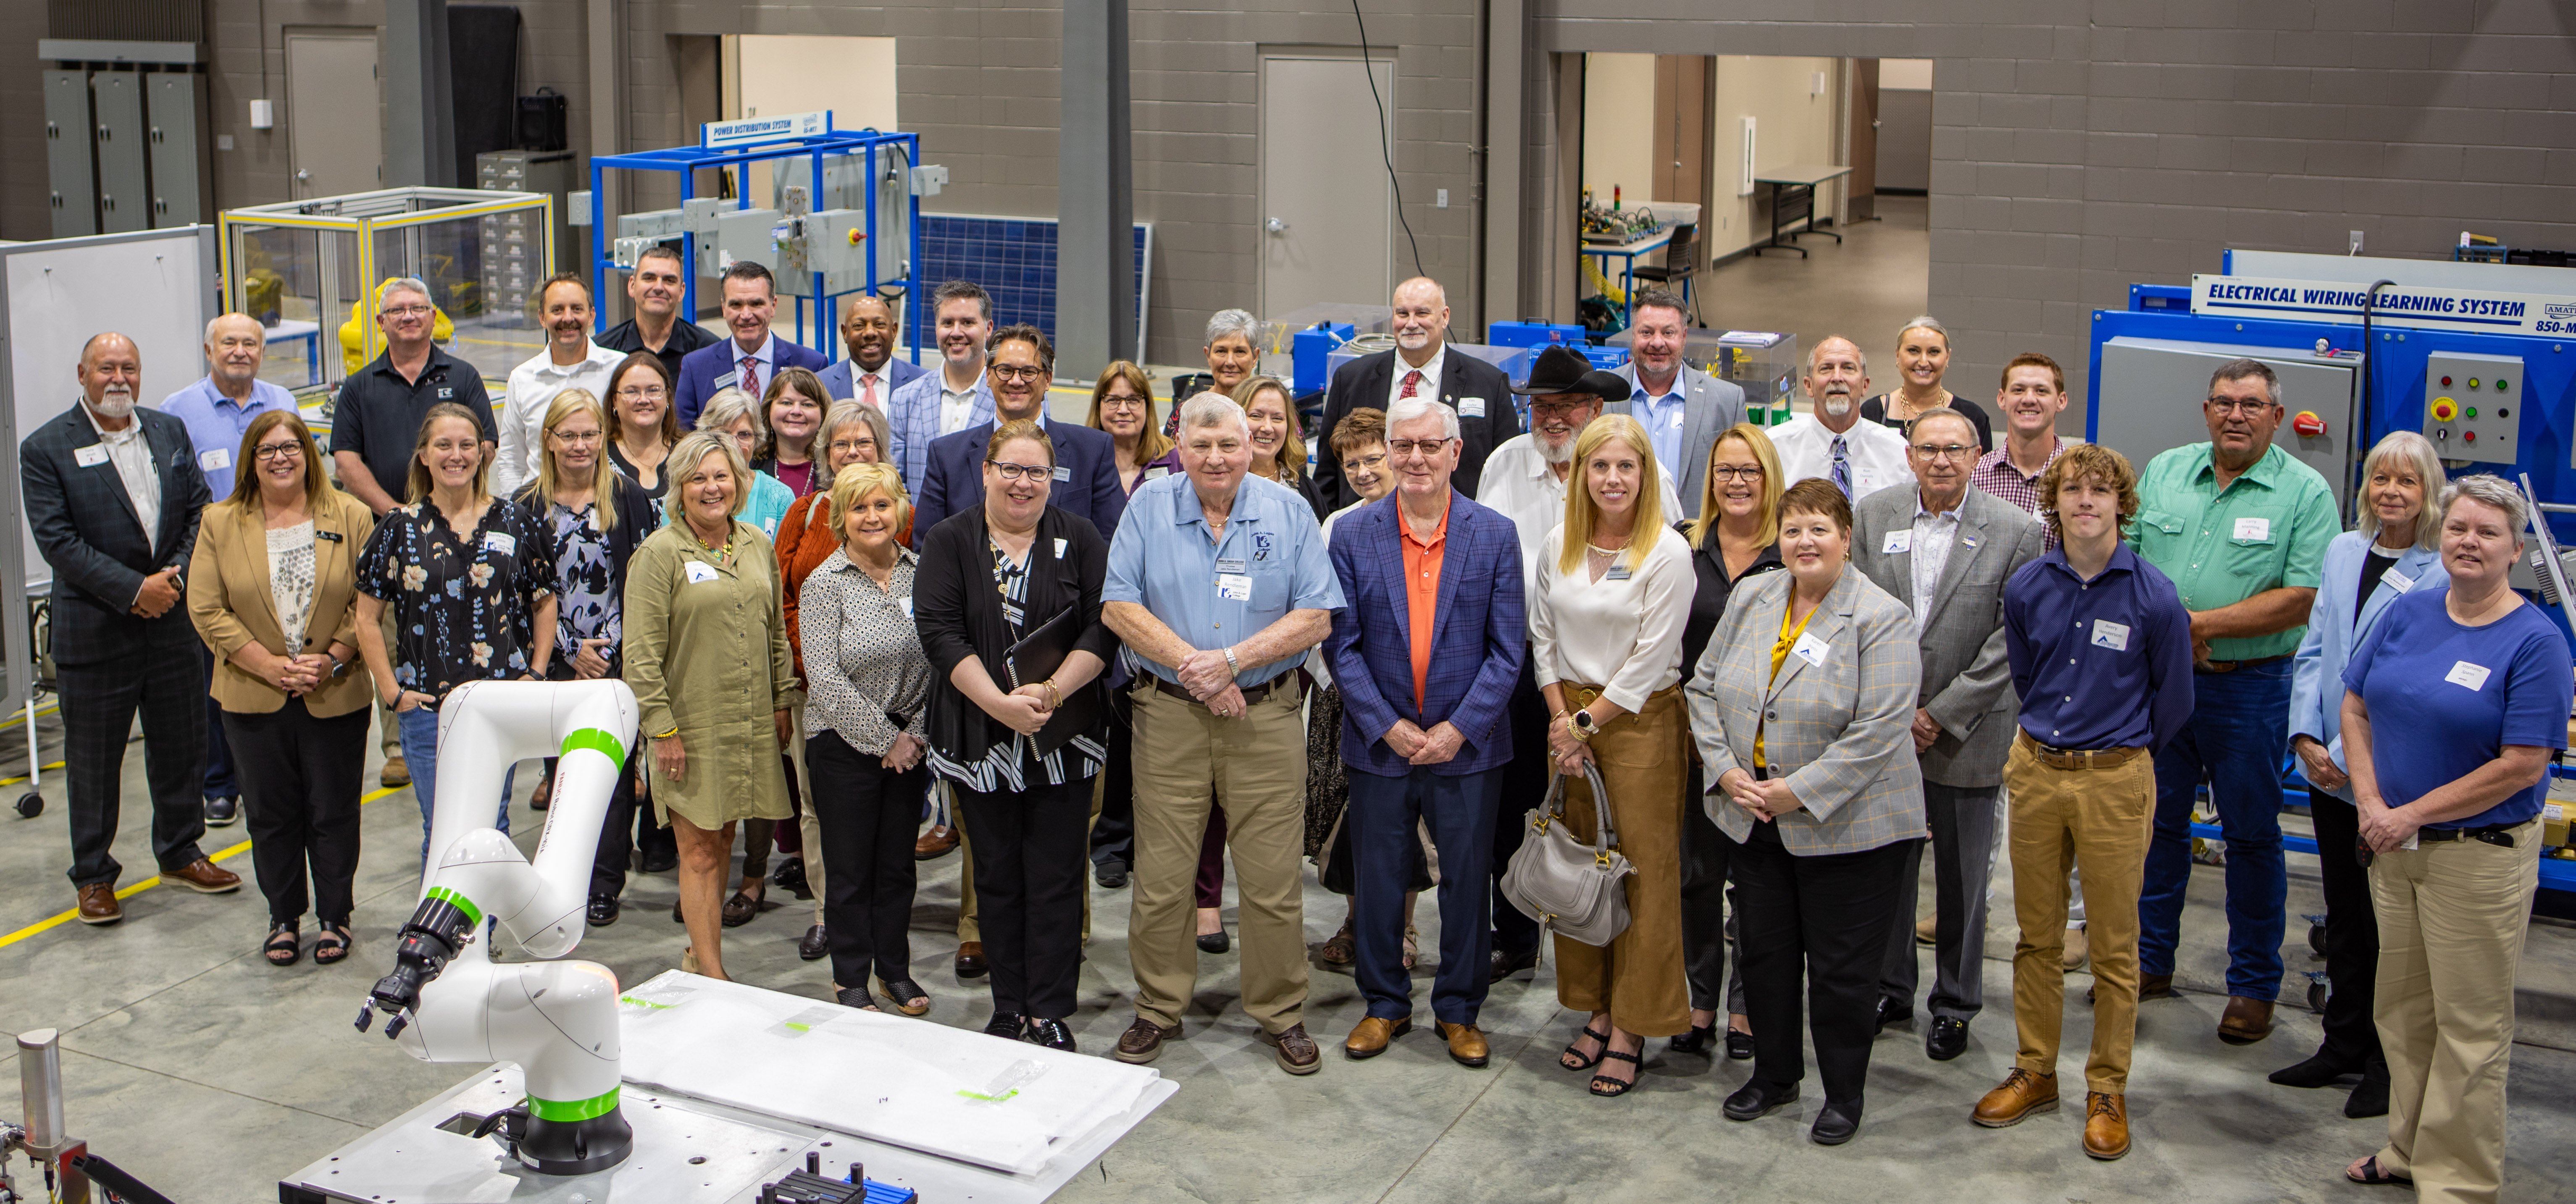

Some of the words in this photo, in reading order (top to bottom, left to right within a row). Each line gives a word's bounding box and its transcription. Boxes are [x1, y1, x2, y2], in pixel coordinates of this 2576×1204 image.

[714, 126, 733, 136] POWER
[734, 122, 770, 134] DISTRIBUTION
[773, 119, 791, 129] SYSTEM
[2208, 284, 2297, 302] ELECTRICAL
[2303, 289, 2366, 308] WIRING
[2371, 293, 2455, 313] LEARNING
[2459, 299, 2526, 317] SYSTEM
[2098, 629, 2122, 638] Henderson
[2461, 664, 2482, 673] Stephanie
[556, 771, 565, 797] FANUC
[550, 797, 560, 820] Robot
